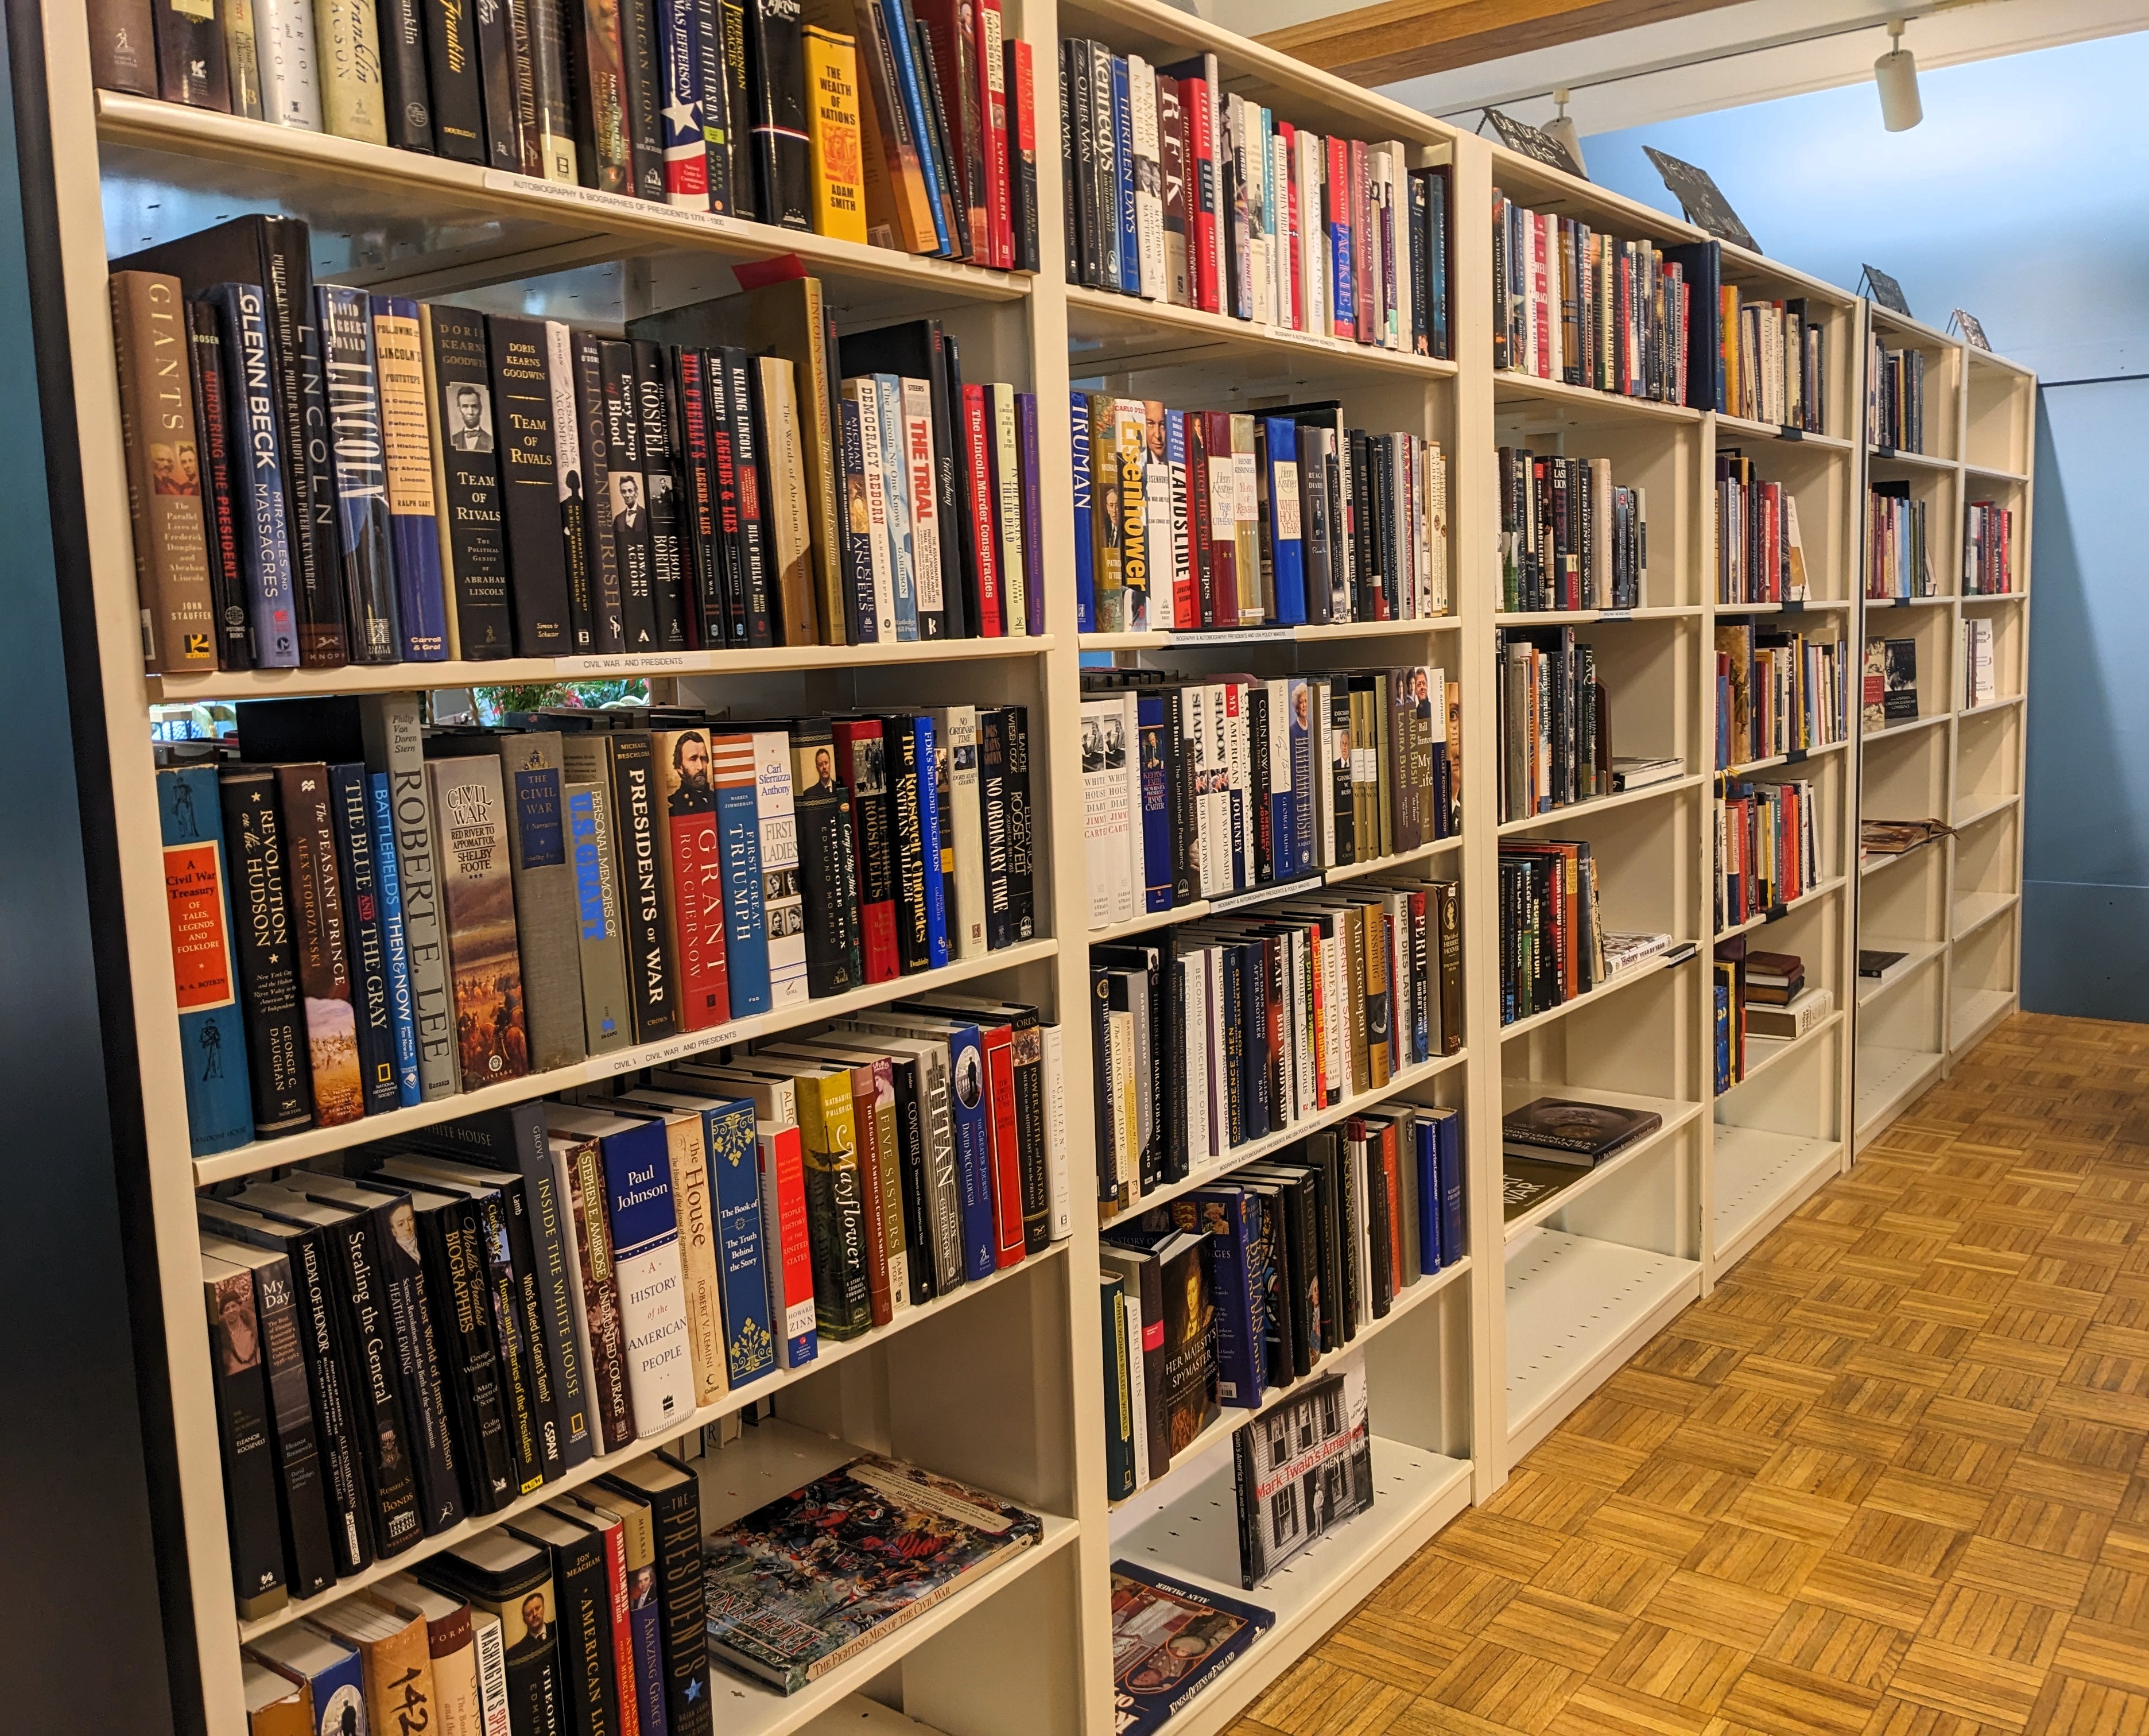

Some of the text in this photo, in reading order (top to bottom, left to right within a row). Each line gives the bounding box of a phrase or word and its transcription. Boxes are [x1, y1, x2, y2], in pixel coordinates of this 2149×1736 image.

[984, 11, 998, 89] IMPOSSIBLE
[992, 12, 1003, 90] FAILURE IS
[825, 65, 841, 80] THE
[820, 78, 852, 96] WEALTH
[831, 95, 841, 108] OF
[1095, 48, 1114, 172] Kennedys
[820, 106, 856, 126] NATIONS
[1119, 96, 1136, 234] THIRTEEN DAYS
[513, 180, 576, 198] AUTOBIOGRAPHY
[586, 193, 634, 208] BIOGRAPHIES
[635, 202, 645, 210] OF
[647, 204, 689, 220] PRESIDENTS
[691, 214, 704, 222] 1774
[830, 197, 856, 211] SMITH
[831, 184, 854, 199] ADAM
[1337, 224, 1352, 306] JACKIE
[149, 283, 184, 429] GIANTS
[506, 356, 541, 367] KEARNS
[509, 343, 536, 354] DORIS
[240, 294, 276, 469] GLENN BECK
[503, 368, 545, 381] GOODWIN
[907, 384, 925, 393] STEERS
[510, 414, 546, 431] TEAM
[641, 381, 663, 458] GOSPEL
[732, 367, 752, 459] KILLING LINCOLN
[523, 436, 538, 446] OF
[510, 448, 552, 466] RIVALS
[862, 387, 884, 525] DEMOCRACY REBORN
[1071, 404, 1091, 509] TRUMAN
[1555, 459, 1566, 468] THE
[910, 420, 933, 523] THE TRIAL
[971, 409, 994, 599] The Lincoln Murder Conspiracies
[1121, 421, 1147, 592] Eisenhower
[1279, 499, 1299, 510] WHITE
[1279, 510, 1300, 522] HOUSE
[1171, 464, 1190, 581] LANDSLIDE
[1282, 521, 1300, 533] YEARS
[254, 483, 278, 597] MASSACRES
[584, 660, 602, 668] CIVIL
[603, 659, 620, 667] WAR
[641, 657, 683, 666] PRESIDENTS
[1583, 649, 1593, 685] IRAQ
[1193, 694, 1204, 768] SHADOW
[759, 773, 791, 785] Sferrazza
[766, 764, 782, 774] Carl
[1228, 695, 1243, 854] MY AMERICAN JOURNEY
[447, 784, 493, 809] CIVIL
[761, 785, 790, 797] Anthony
[453, 803, 489, 826] WAR
[451, 826, 495, 840] RED RIVER TO
[452, 837, 496, 851] APPOMATTOX
[766, 820, 793, 841] FIRST
[187, 860, 195, 870] A
[457, 848, 492, 862] SHELBY
[763, 840, 798, 863] LADIES
[166, 870, 216, 886] Civil War
[259, 809, 288, 945] REVOLUTION
[460, 860, 492, 873] FOOTE
[169, 885, 215, 899] Treasury
[629, 768, 664, 1005] PRESIDENTS OF WAR
[699, 828, 727, 972] GRANT
[182, 910, 210, 921] TALES,
[189, 901, 200, 909] OF
[247, 858, 271, 947] HUDSON
[344, 780, 387, 1029] THE BLUE AND THE GRAY
[394, 768, 449, 1063] ROBERT E. LEE
[178, 920, 215, 932] LEGENDS
[188, 932, 208, 941] AND
[177, 940, 220, 953] FOLKLORE
[1415, 916, 1426, 971] PERIL
[1620, 942, 1665, 967] History YEAR BY YEAR
[1403, 974, 1411, 1005] LAST
[645, 1030, 738, 1062] CIVIL WAR AND PRESIDENTS
[930, 1078, 953, 1189] TITAN
[627, 1164, 655, 1187] Paul
[881, 1115, 900, 1250] FIVE SISTERS
[618, 1180, 669, 1211] Johnson
[836, 1125, 861, 1269] Mayflower
[263, 1279, 284, 1294] My
[265, 1291, 291, 1308] Day
[538, 1178, 580, 1398] INSIDE THE WHITE HOUSE
[630, 1276, 677, 1306] HISTORY
[349, 1231, 392, 1405] Stealing the General
[789, 1316, 814, 1332] ZINN
[629, 1316, 688, 1352] AMERICAN
[643, 1345, 682, 1373] PEOPLE
[1166, 1327, 1216, 1375] HER MAJESTY'S
[1172, 1350, 1212, 1388] SPYMASTER
[1257, 1425, 1363, 1498] Mark Twain's America
[1321, 1439, 1366, 1471] THEN AND NOW
[671, 1493, 688, 1512] THE
[664, 1507, 707, 1679] PRESIDENTS
[813, 1586, 952, 1676] THE FIGHTING MEN OF THE CIVIL WAR
